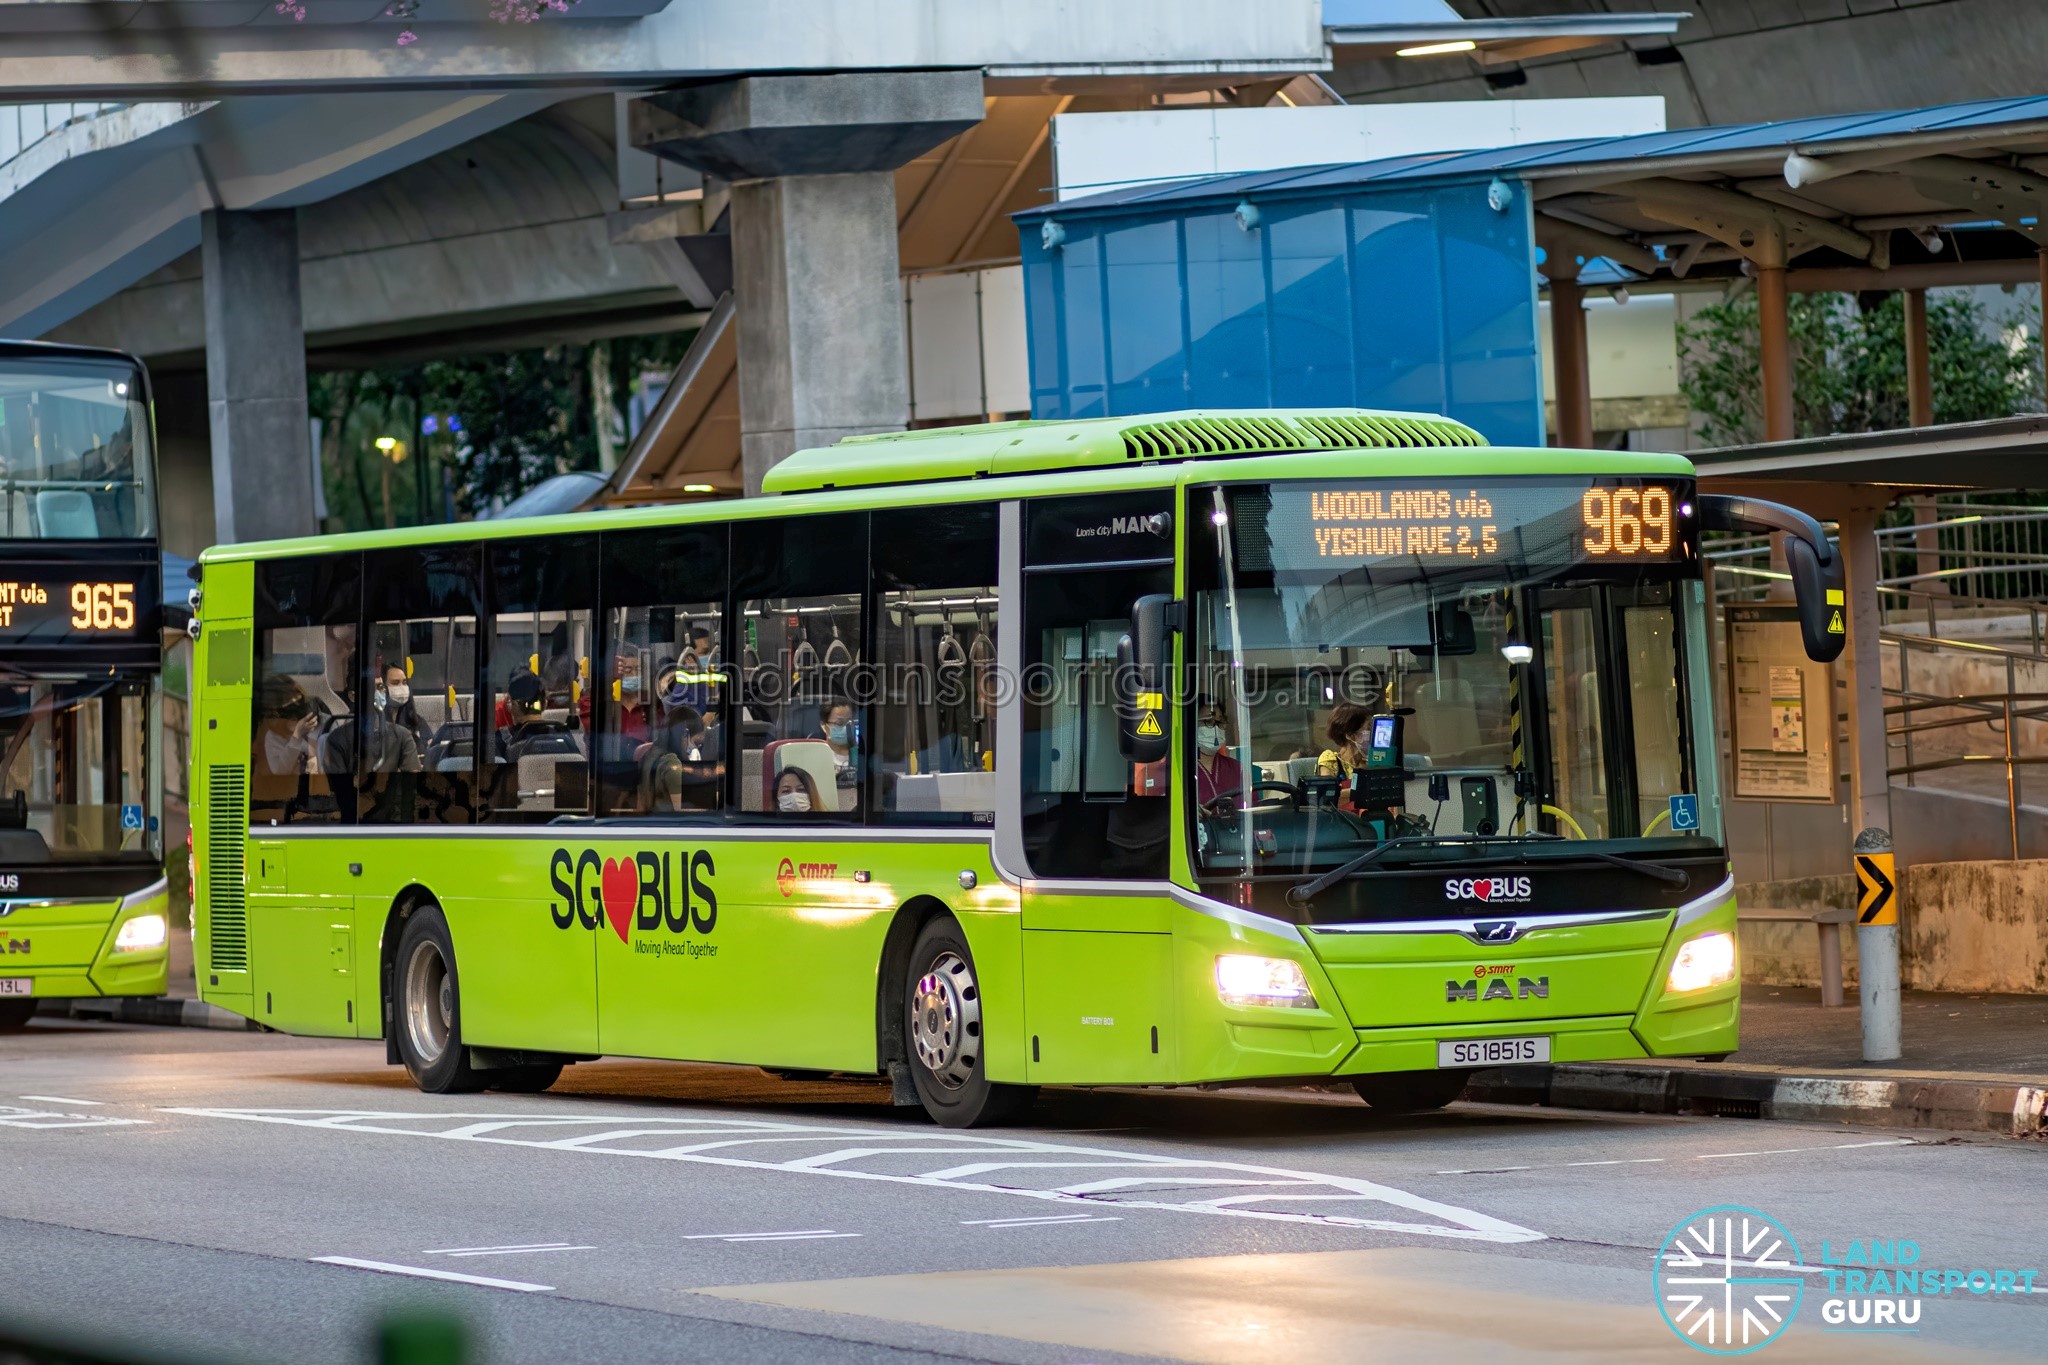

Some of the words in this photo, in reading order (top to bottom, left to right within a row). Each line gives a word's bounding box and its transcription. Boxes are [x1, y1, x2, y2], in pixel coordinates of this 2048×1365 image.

[1312, 490, 1451, 520] WOODLANDS
[1455, 490, 1492, 518] via
[1097, 526, 1112, 537] City
[1112, 515, 1153, 535] MAN
[1583, 487, 1671, 554] 969
[1315, 526, 1406, 556] YISHUN
[1407, 525, 1452, 554] AVE
[20, 582, 48, 604] via
[0, 605, 13, 627] T
[71, 582, 135, 630] 965
[0, 874, 19, 889] US
[798, 862, 839, 880] SMRT
[635, 939, 661, 959] Moving
[662, 939, 686, 956] Ahead
[686, 940, 719, 960] Together
[1487, 965, 1516, 974] SMRT
[1446, 976, 1549, 1002] MAN
[1081, 1016, 1102, 1025] BATTERY
[1453, 1040, 1536, 1063] SG1851S
